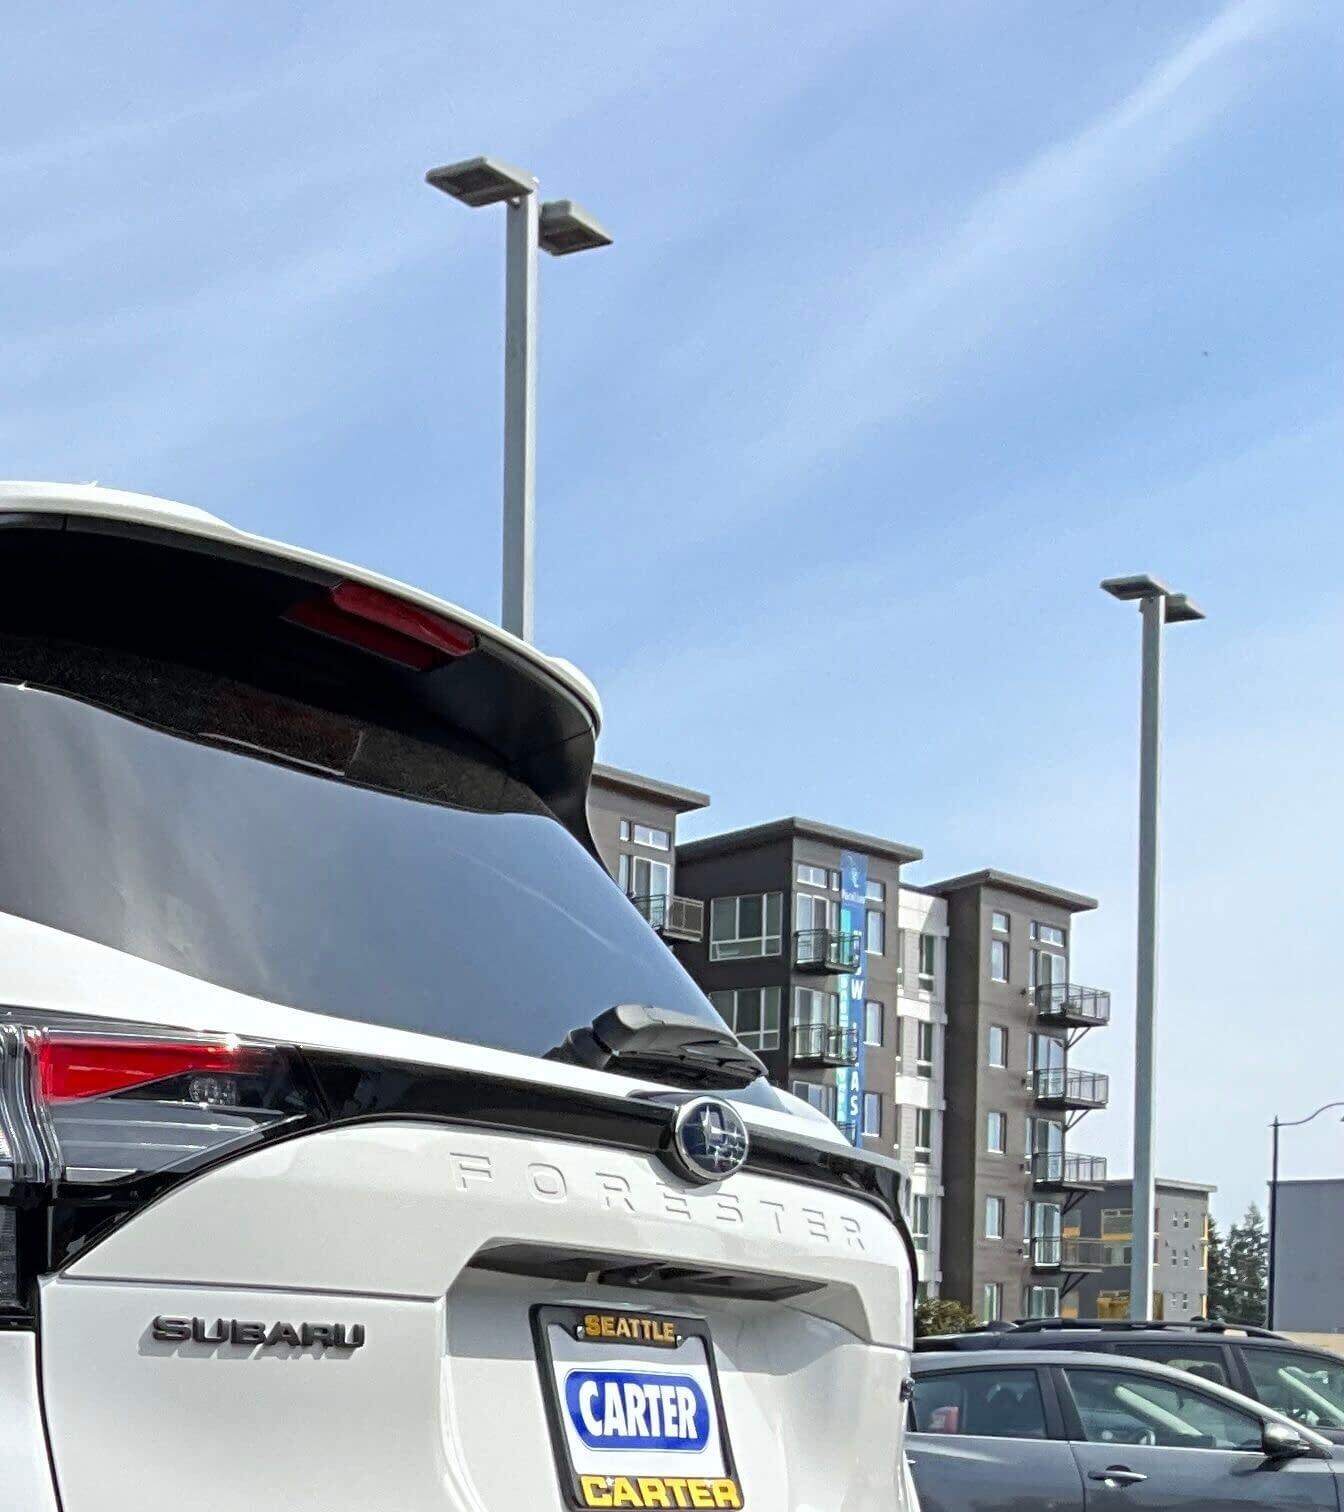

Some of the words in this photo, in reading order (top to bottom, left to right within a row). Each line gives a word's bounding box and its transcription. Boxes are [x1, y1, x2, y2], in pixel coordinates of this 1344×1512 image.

[449, 1151, 867, 1252] FORESTER
[151, 1314, 366, 1349] SUBARU
[584, 1314, 677, 1343] SEATTLE
[578, 1380, 699, 1440] CARTER
[579, 1475, 741, 1509] CARTER
